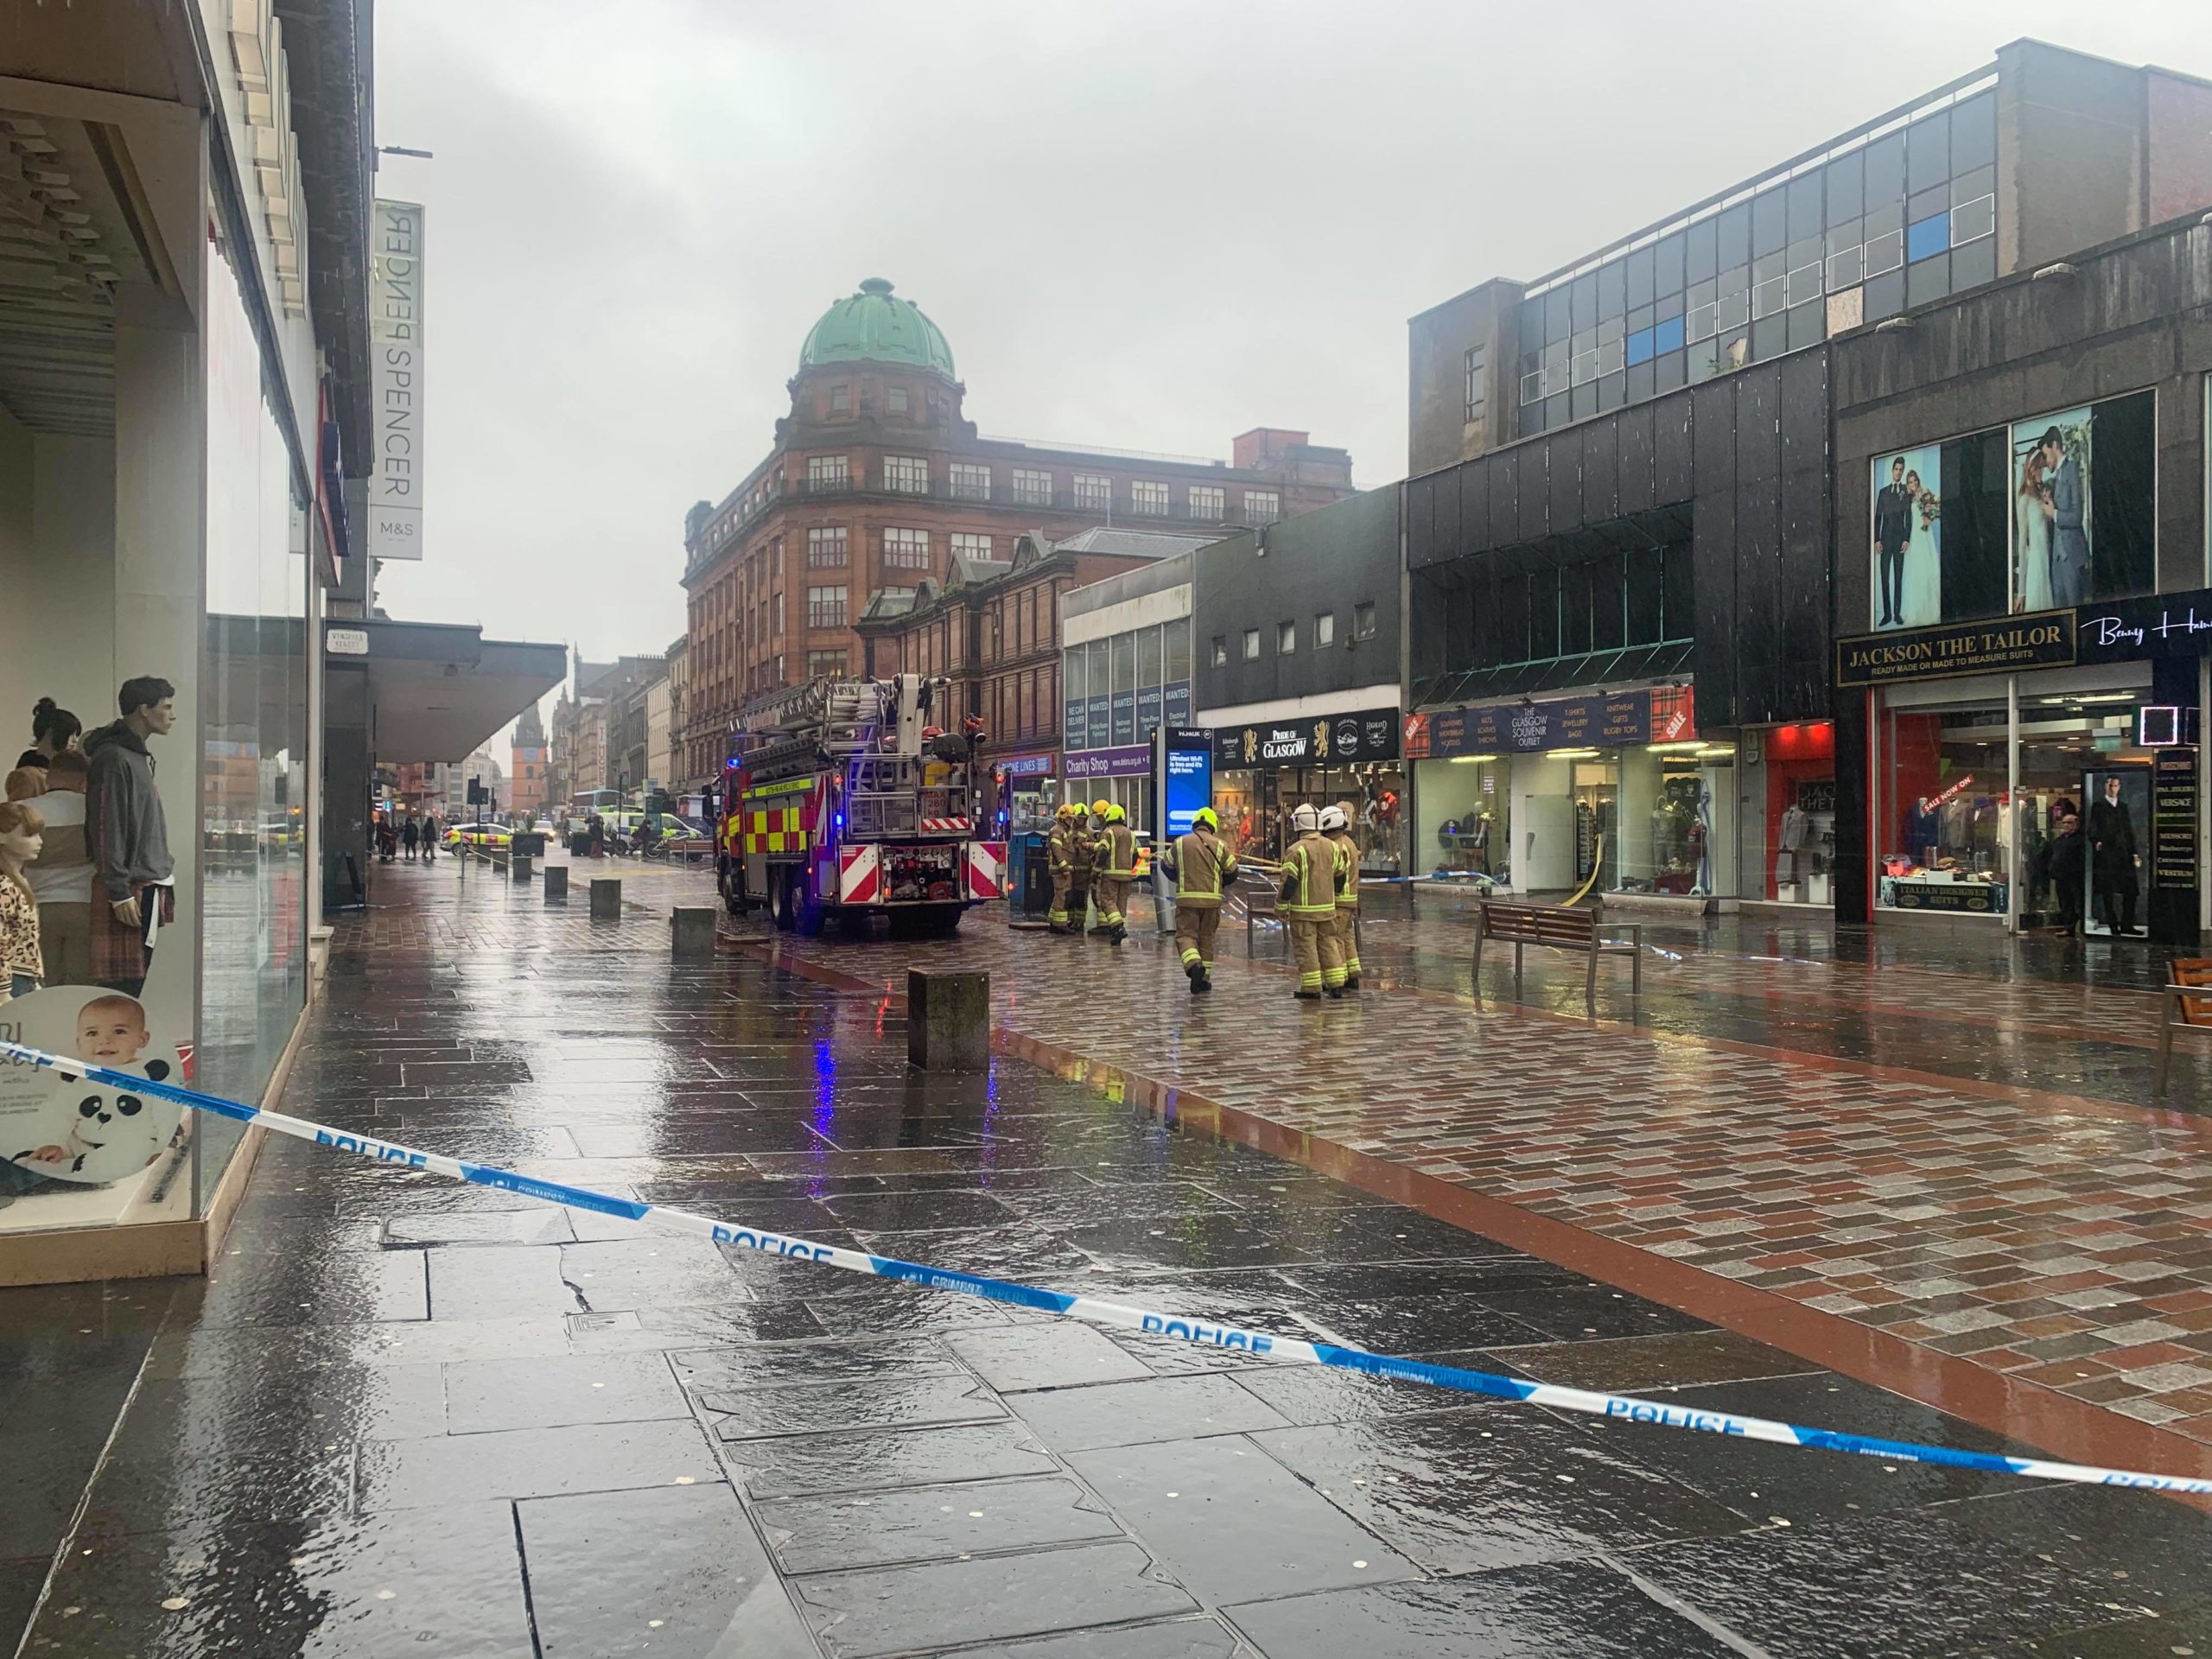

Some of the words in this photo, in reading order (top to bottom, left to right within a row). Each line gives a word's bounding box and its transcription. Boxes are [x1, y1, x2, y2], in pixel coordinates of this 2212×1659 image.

[385, 347, 411, 496] SPENCER
[380, 521, 414, 537] M&S
[1849, 641, 1933, 668] JACKSON
[1936, 635, 1977, 657] THE
[1981, 625, 2062, 651] TAILOR
[1872, 665, 1896, 676] READY
[1897, 662, 1918, 673] MADE
[1920, 660, 1931, 671] OR
[1932, 658, 1955, 669] MADE
[1955, 657, 1967, 665] TO
[1967, 652, 2007, 664] MEASURE
[2009, 649, 2034, 659] SUITS
[1165, 688, 1190, 702] WANTED:
[1068, 707, 1074, 715] WE
[1075, 705, 1084, 715] CAN
[1523, 708, 1535, 716] THE
[1564, 708, 1586, 716] T-SHIRTS
[1606, 702, 1635, 713] KNITWEAR
[1067, 715, 1085, 727] DELIVER
[1512, 715, 1548, 728] GLASGOW
[1562, 719, 1589, 728] JEWELLERY
[1612, 715, 1629, 723] GIFTS
[1666, 710, 1687, 739] SALE
[1272, 729, 1289, 741] PRIDE
[1289, 730, 1298, 739] OF
[1512, 726, 1547, 738] SOUVENIR
[1603, 727, 1622, 735] RUGBY
[1624, 725, 1637, 734] TOPS
[1518, 737, 1541, 747] OUTLET
[1262, 740, 1306, 759] GLASGOW
[1020, 760, 1035, 772] LINES
[1066, 758, 1090, 776] Charity
[1090, 757, 1109, 774] Shop
[1924, 797, 1941, 812] SALE
[1941, 785, 1958, 800] NOW
[1959, 777, 1971, 788] ON
[928, 798, 946, 808] 280
[2160, 798, 2192, 807] VERSACE
[927, 808, 939, 818] kg
[1929, 896, 1959, 905] SUITS
